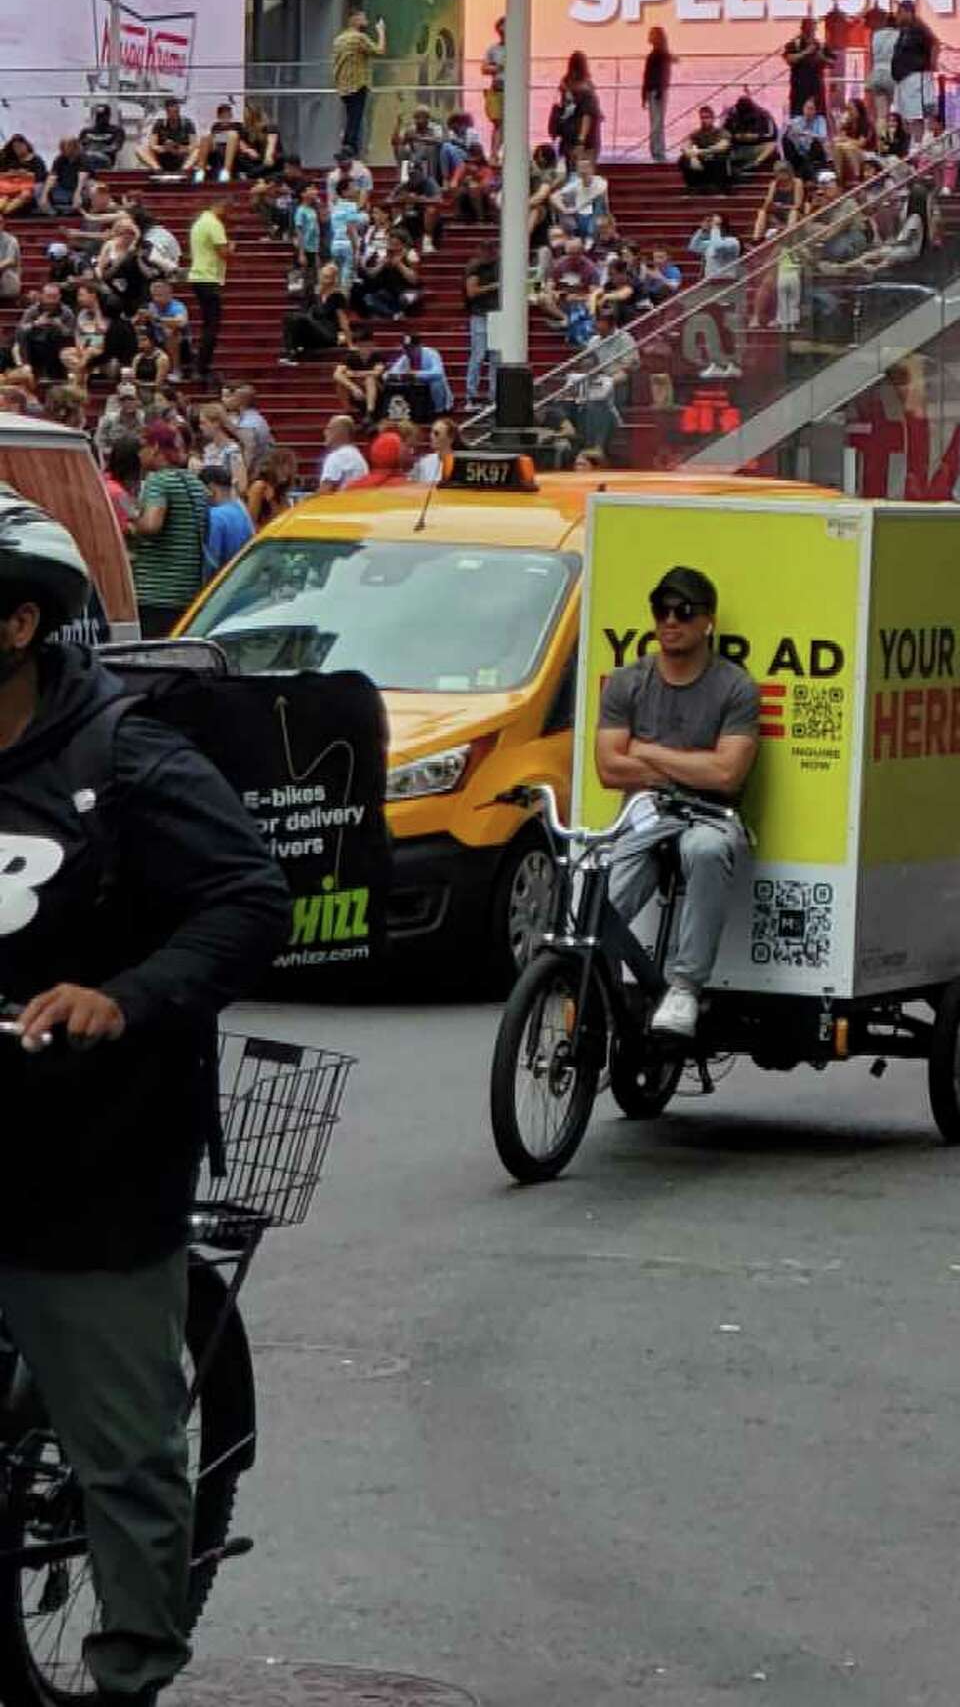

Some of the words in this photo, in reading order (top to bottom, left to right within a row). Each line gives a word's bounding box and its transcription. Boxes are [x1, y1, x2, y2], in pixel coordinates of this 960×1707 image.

[465, 461, 511, 483] 5K97
[602, 628, 751, 670] YR
[767, 637, 845, 678] AD
[879, 627, 956, 681] YOUR
[243, 785, 326, 810] E-bikes
[254, 817, 280, 834] or
[285, 806, 365, 831] delivery
[264, 837, 325, 859] ivers
